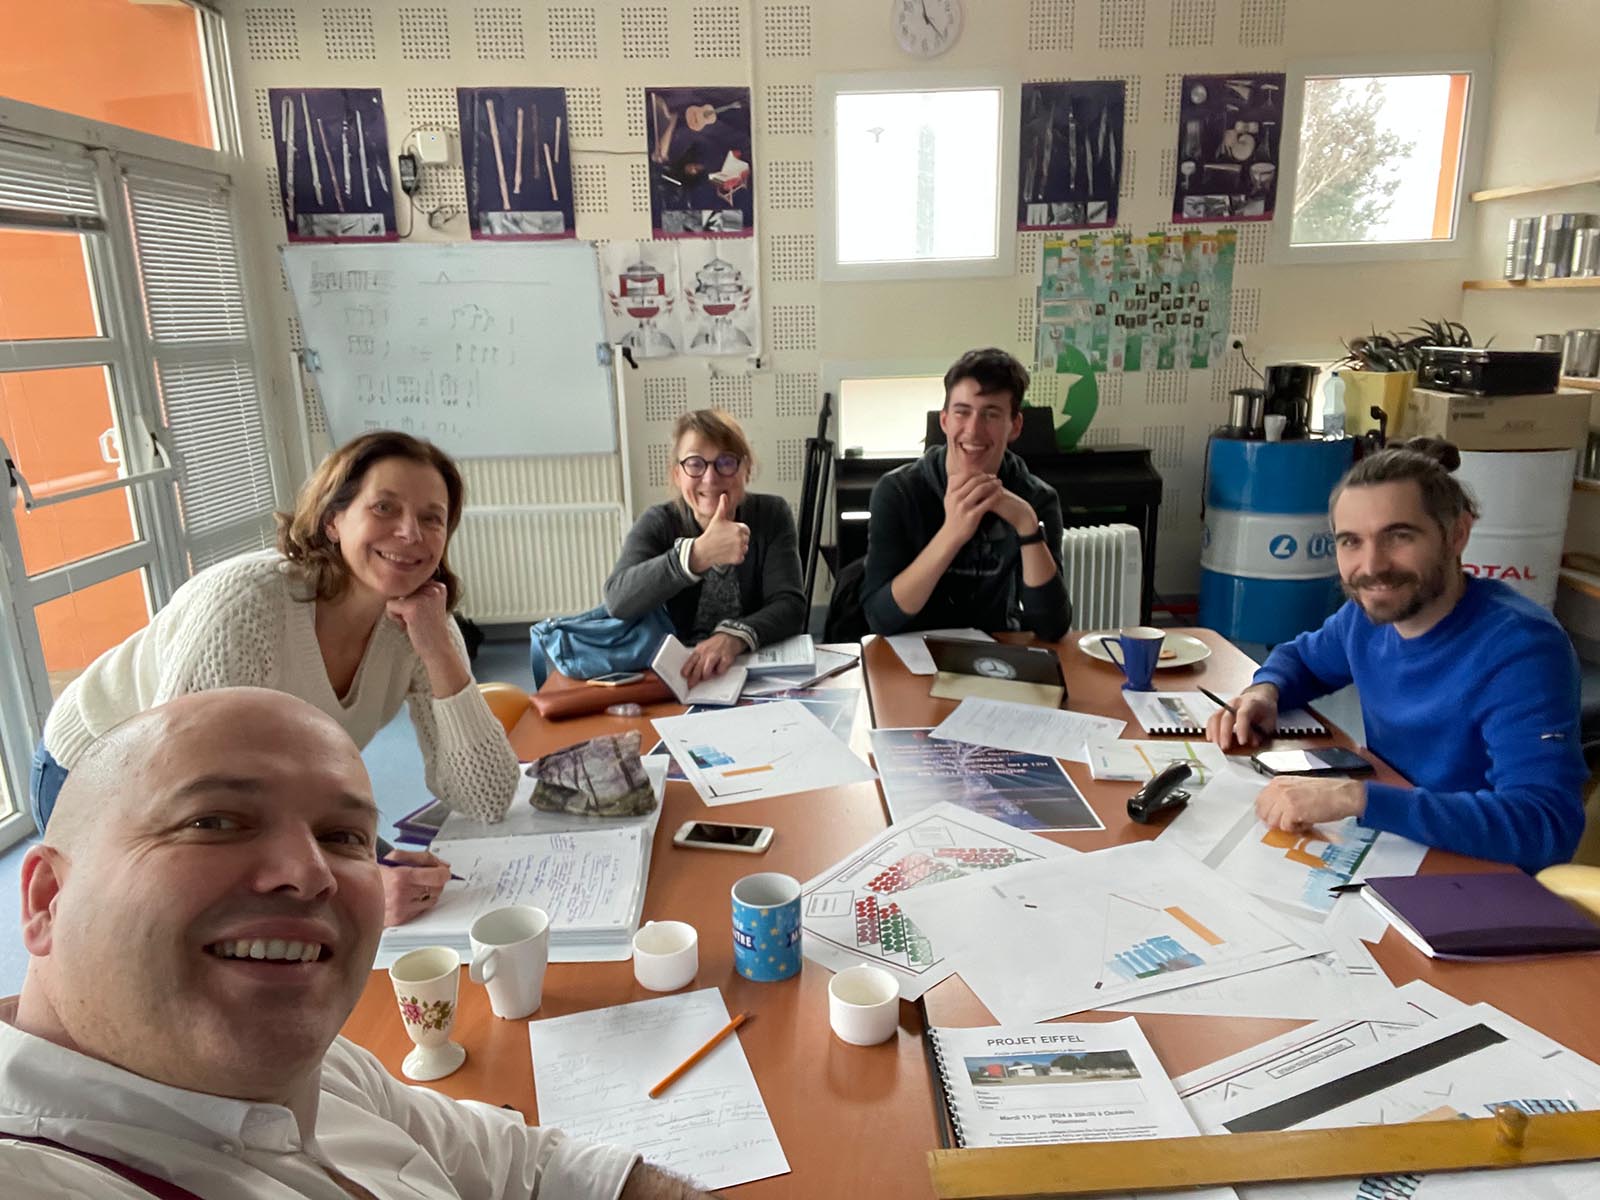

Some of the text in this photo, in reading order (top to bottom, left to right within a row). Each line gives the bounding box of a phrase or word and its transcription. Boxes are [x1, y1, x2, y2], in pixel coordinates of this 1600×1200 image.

[1461, 564, 1537, 580] OTAL
[987, 1034, 1085, 1046] PROJET EIFFEL
